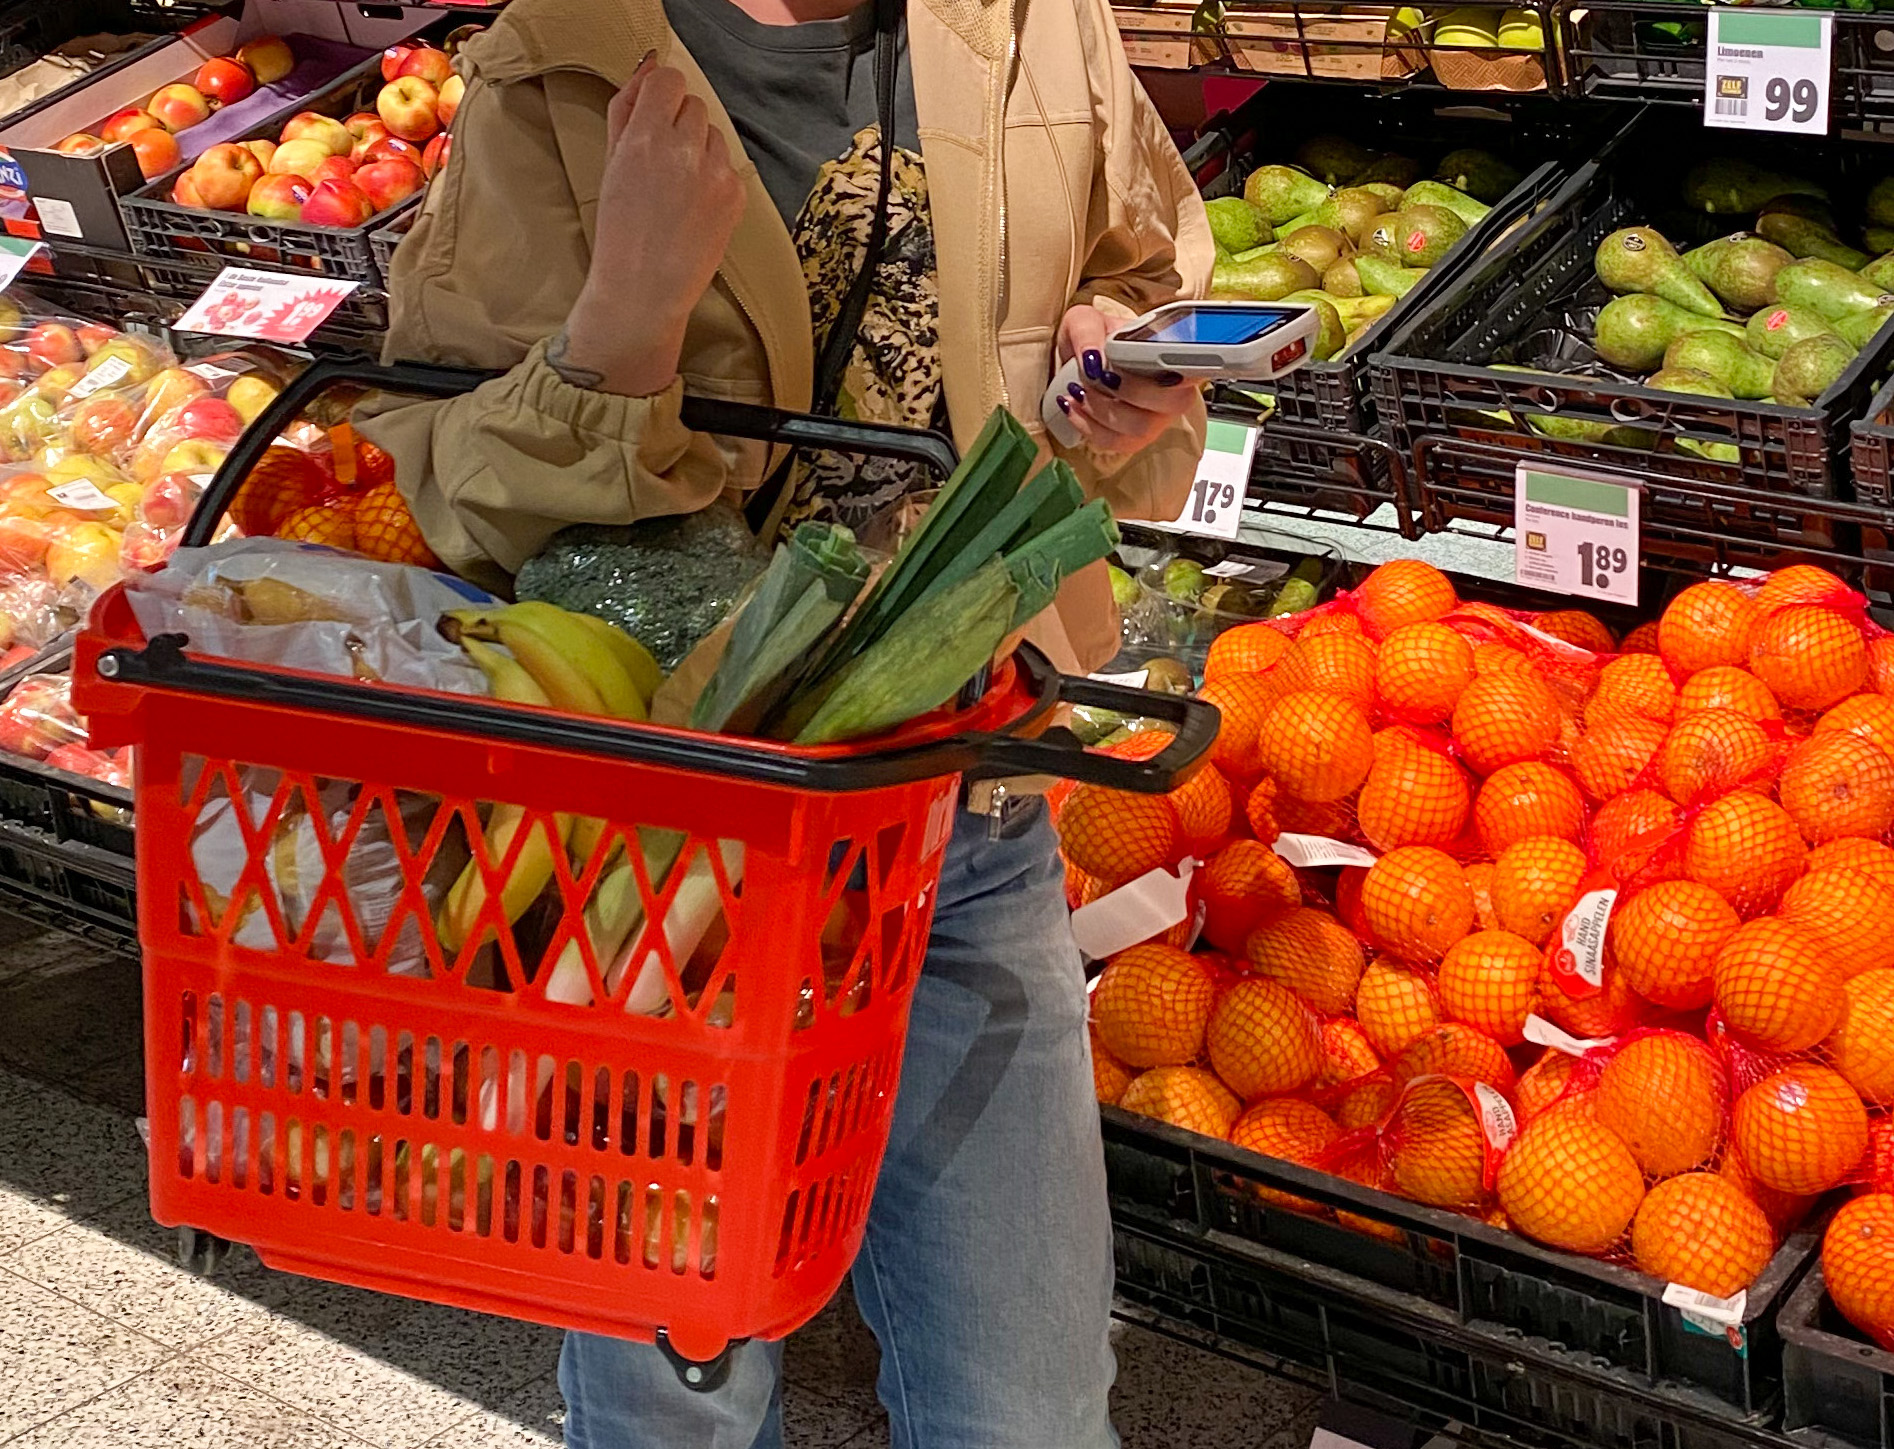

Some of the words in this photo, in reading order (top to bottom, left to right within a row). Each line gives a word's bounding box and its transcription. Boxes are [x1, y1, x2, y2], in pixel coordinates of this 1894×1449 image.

[1718, 46, 1763, 58] Limoenen
[1765, 77, 1818, 123] 99
[1576, 917, 1590, 946] HAND
[1585, 897, 1609, 976] SINAASAPPELEN
